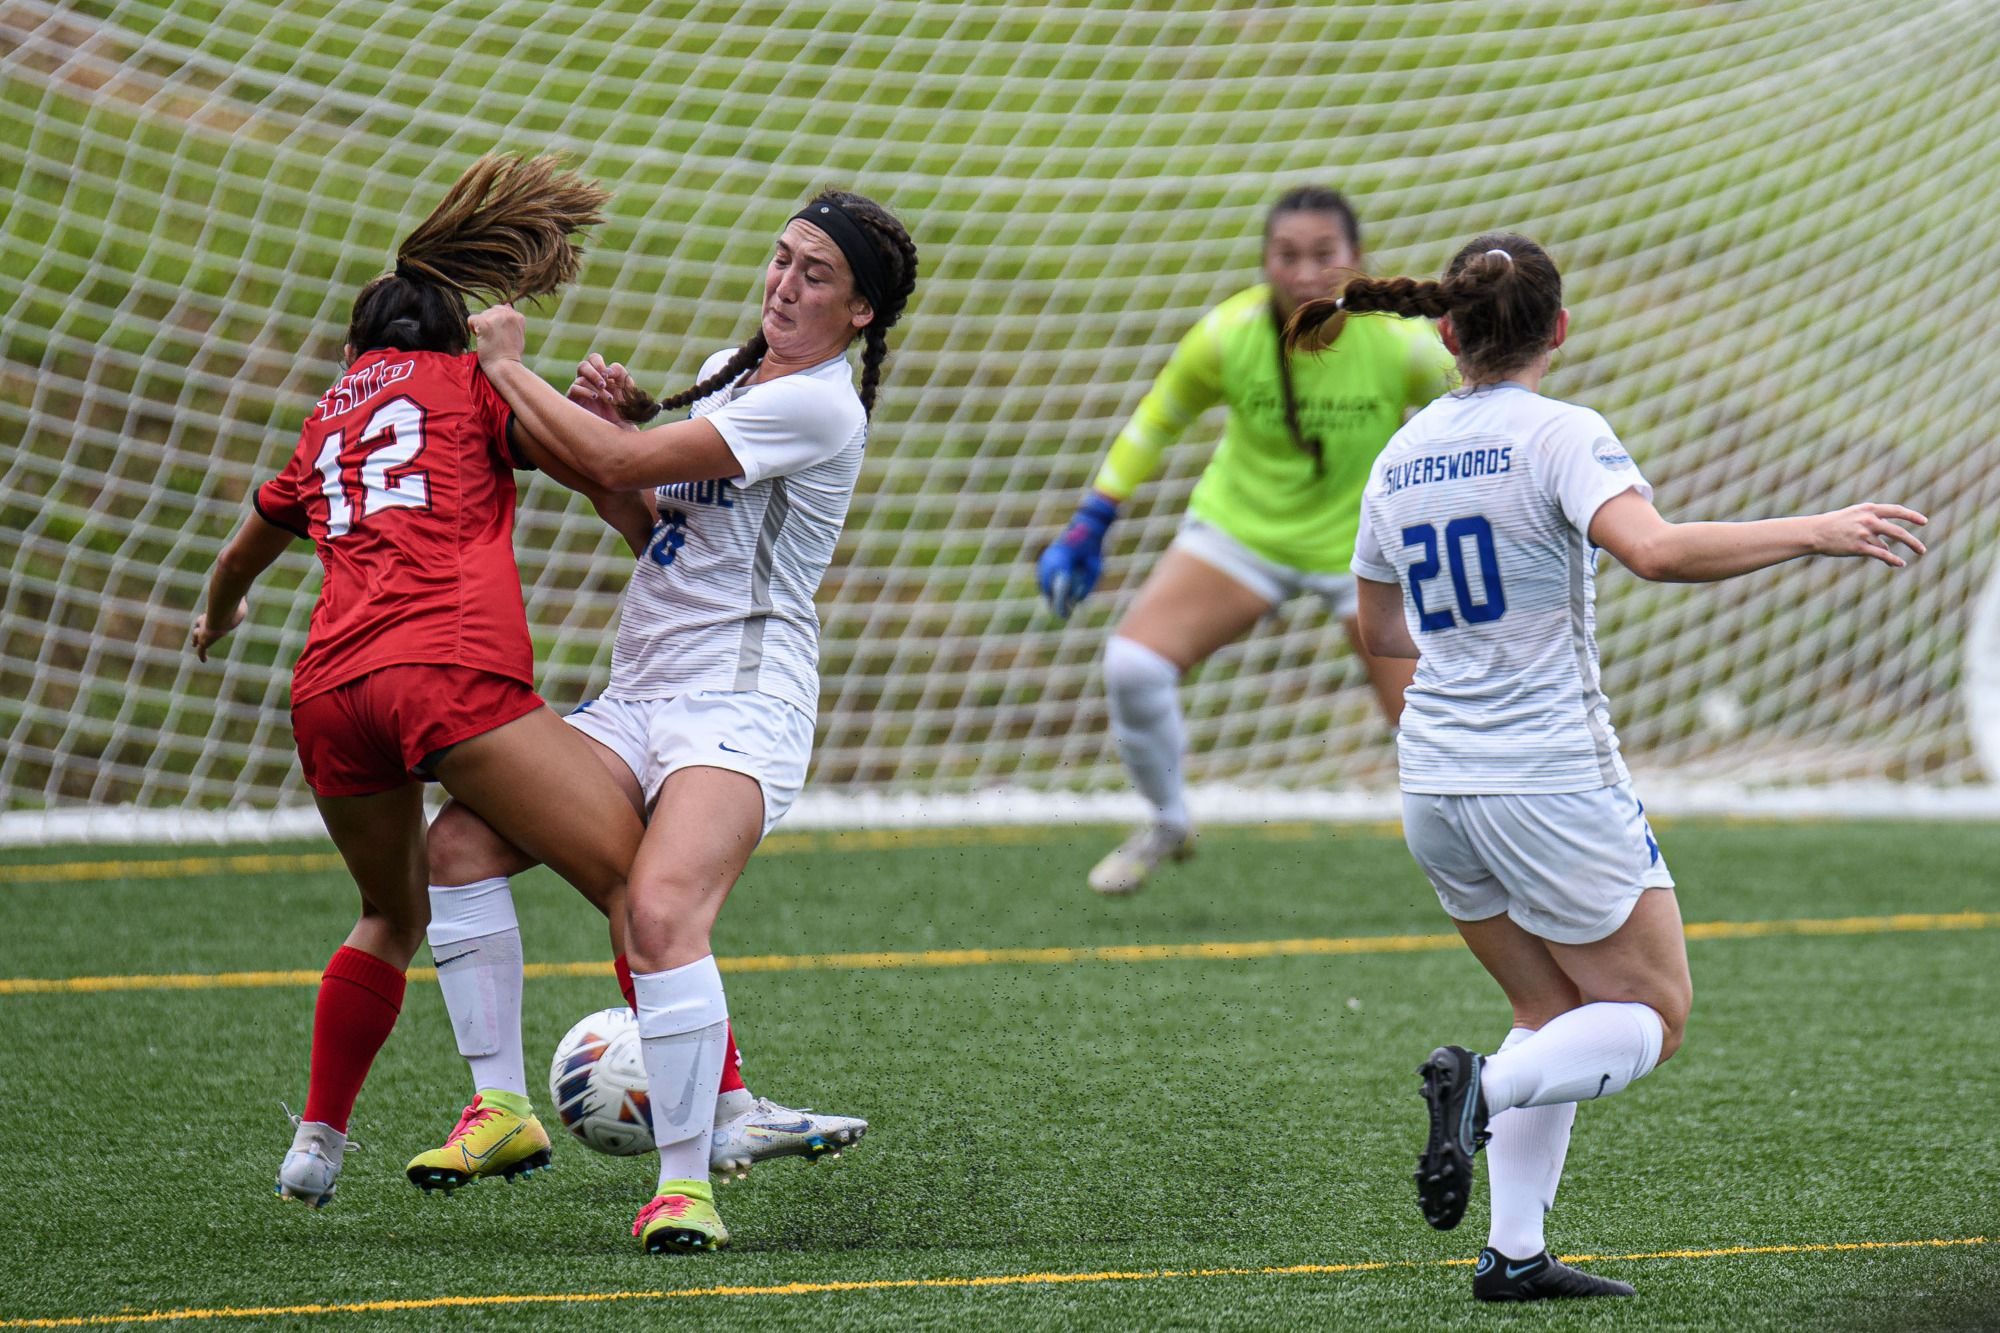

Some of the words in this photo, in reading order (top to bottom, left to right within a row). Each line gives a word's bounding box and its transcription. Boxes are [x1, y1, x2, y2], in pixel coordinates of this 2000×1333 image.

[311, 393, 433, 544] 12
[1386, 446, 1512, 495] SILVERSWORDS
[1400, 513, 1508, 632] 20
